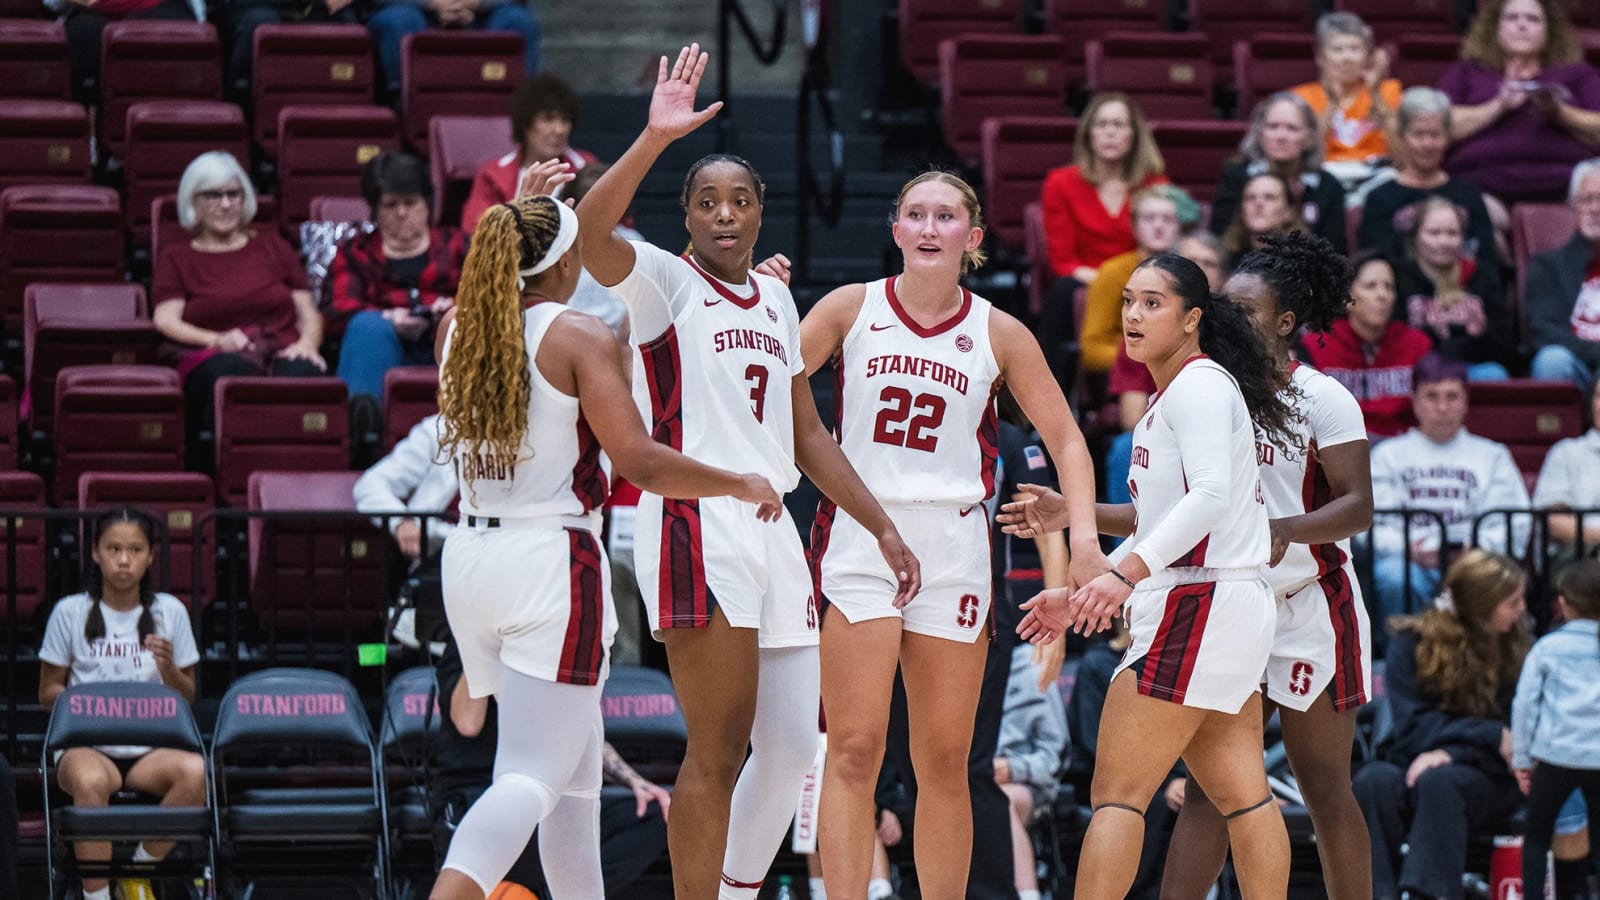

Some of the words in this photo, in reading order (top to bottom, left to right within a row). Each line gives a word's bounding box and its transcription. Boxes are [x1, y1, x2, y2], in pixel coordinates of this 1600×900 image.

[714, 328, 788, 367] STANFORD
[744, 363, 769, 424] 3
[866, 354, 969, 396] STANFORD
[873, 385, 947, 453] 22
[70, 694, 177, 718] STANFORD
[236, 694, 346, 716] STANFORD
